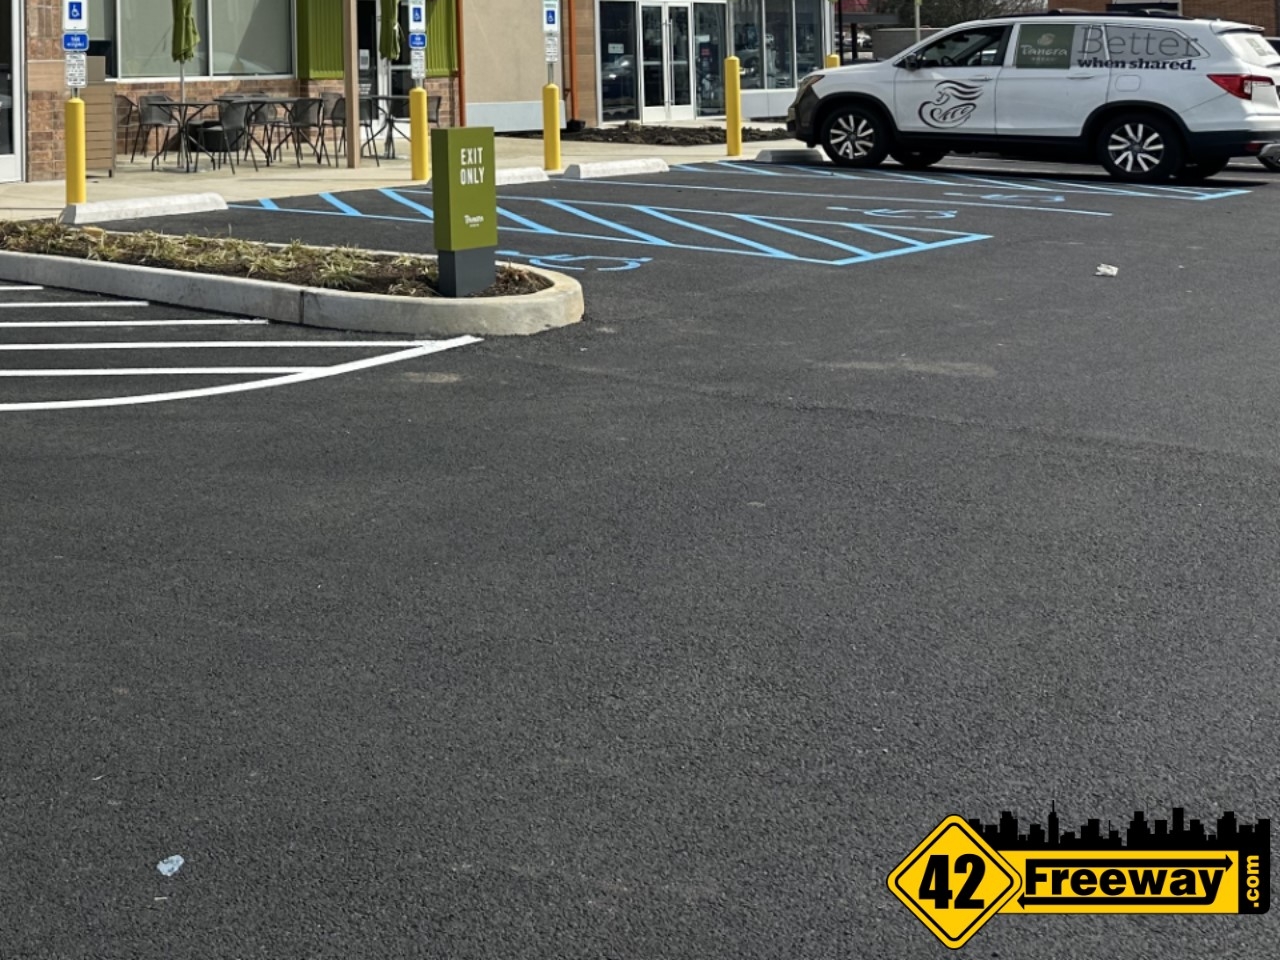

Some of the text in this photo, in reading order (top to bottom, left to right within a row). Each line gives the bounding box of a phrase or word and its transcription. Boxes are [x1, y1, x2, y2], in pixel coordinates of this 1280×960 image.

[1077, 25, 1199, 57] Better
[1020, 44, 1068, 57] Panera
[1077, 58, 1197, 71] when shared.
[460, 147, 483, 165] EXIT
[460, 166, 485, 186] ONLY
